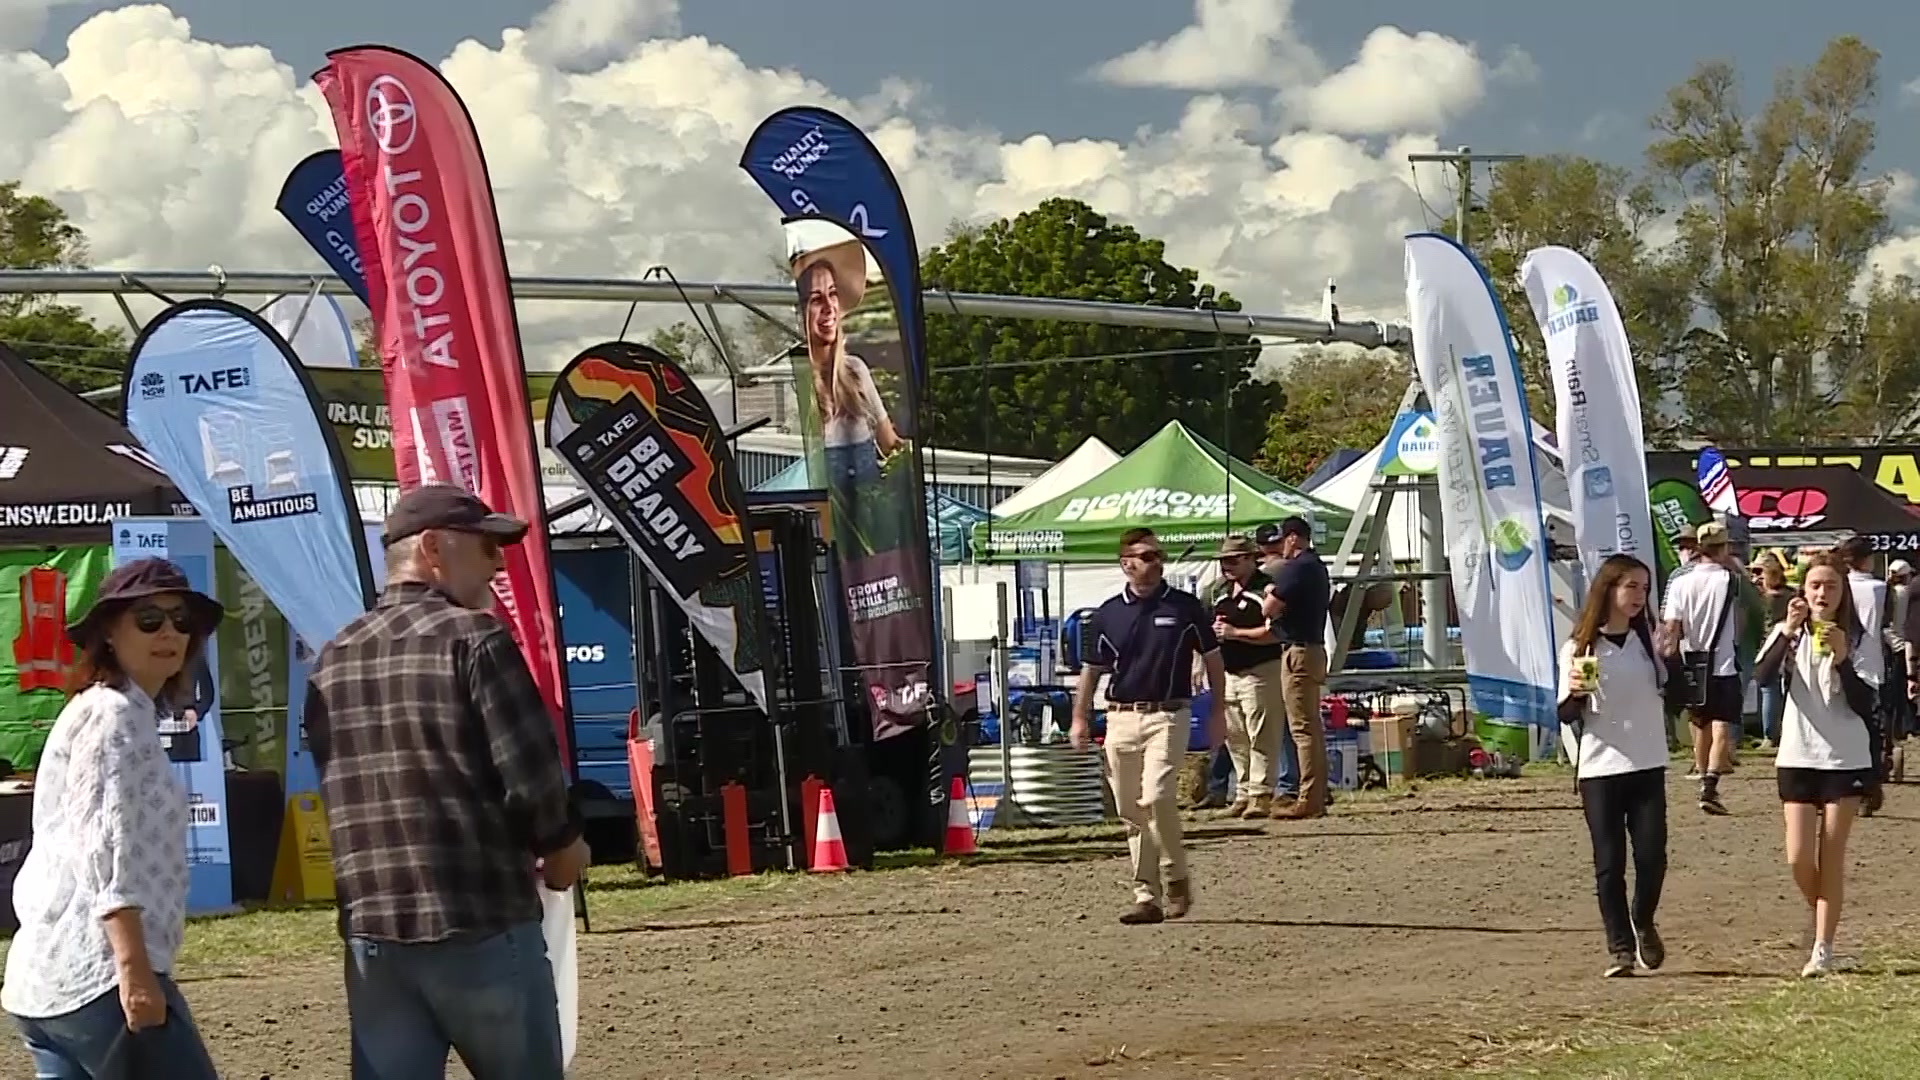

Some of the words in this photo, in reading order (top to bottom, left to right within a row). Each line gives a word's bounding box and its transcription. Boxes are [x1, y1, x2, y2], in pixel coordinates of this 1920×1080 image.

[771, 125, 824, 173] QUALITY
[784, 141, 829, 180] PUMPS
[179, 367, 243, 393] TAFE
[596, 413, 636, 447] TAFE
[630, 435, 675, 480] BE
[232, 488, 250, 503] BE
[233, 496, 315, 521] AMBITIOUS
[606, 455, 705, 561] DEADLY
[1056, 487, 1237, 521] RICHMOND
[1125, 502, 1236, 519] WASTE
[188, 807, 216, 822] TION
